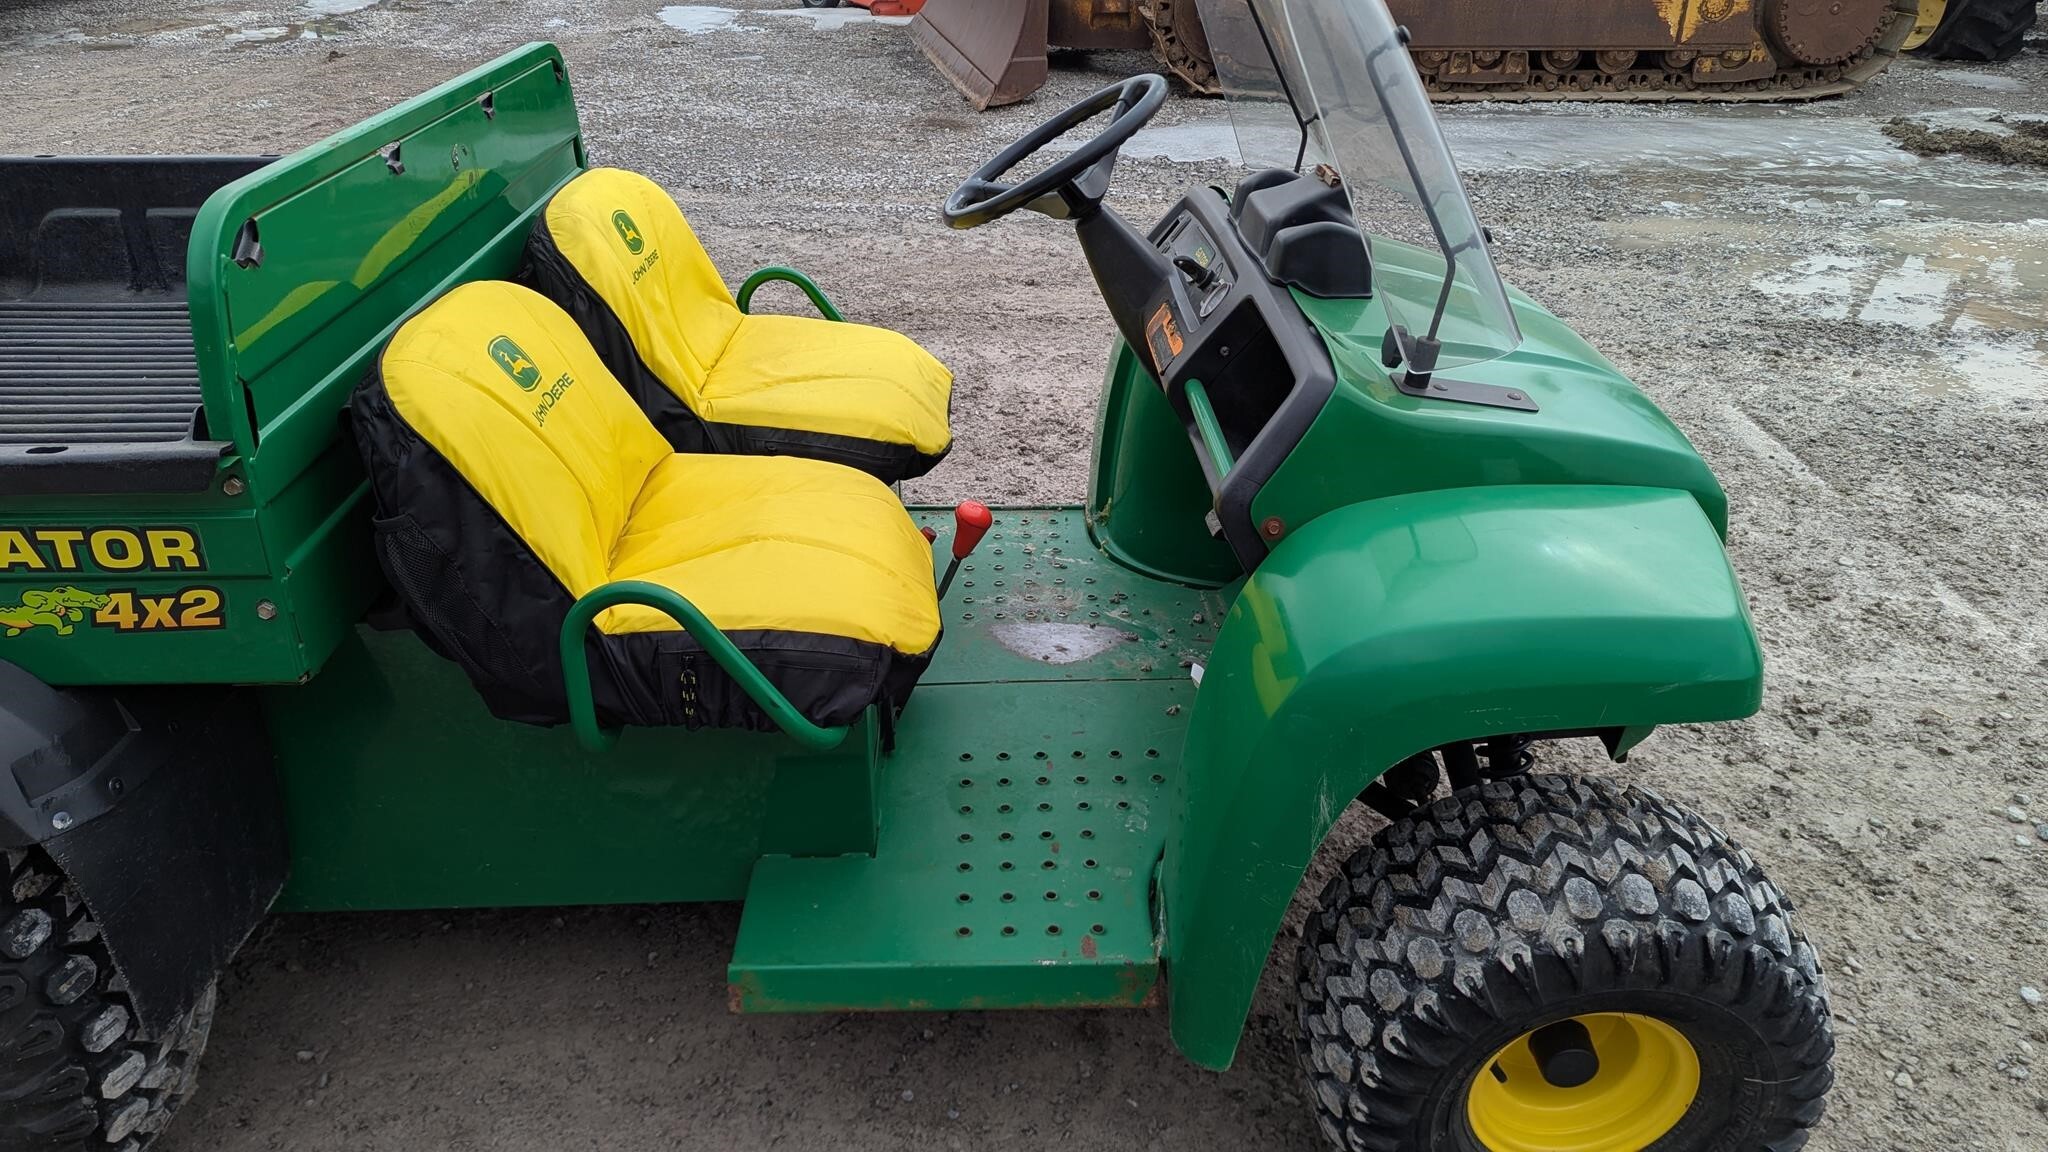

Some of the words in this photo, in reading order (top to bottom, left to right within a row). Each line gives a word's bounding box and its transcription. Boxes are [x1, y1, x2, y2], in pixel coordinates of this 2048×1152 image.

[541, 372, 574, 408] DEERE
[0, 530, 201, 569] ATOR
[95, 588, 221, 630] 4x2
